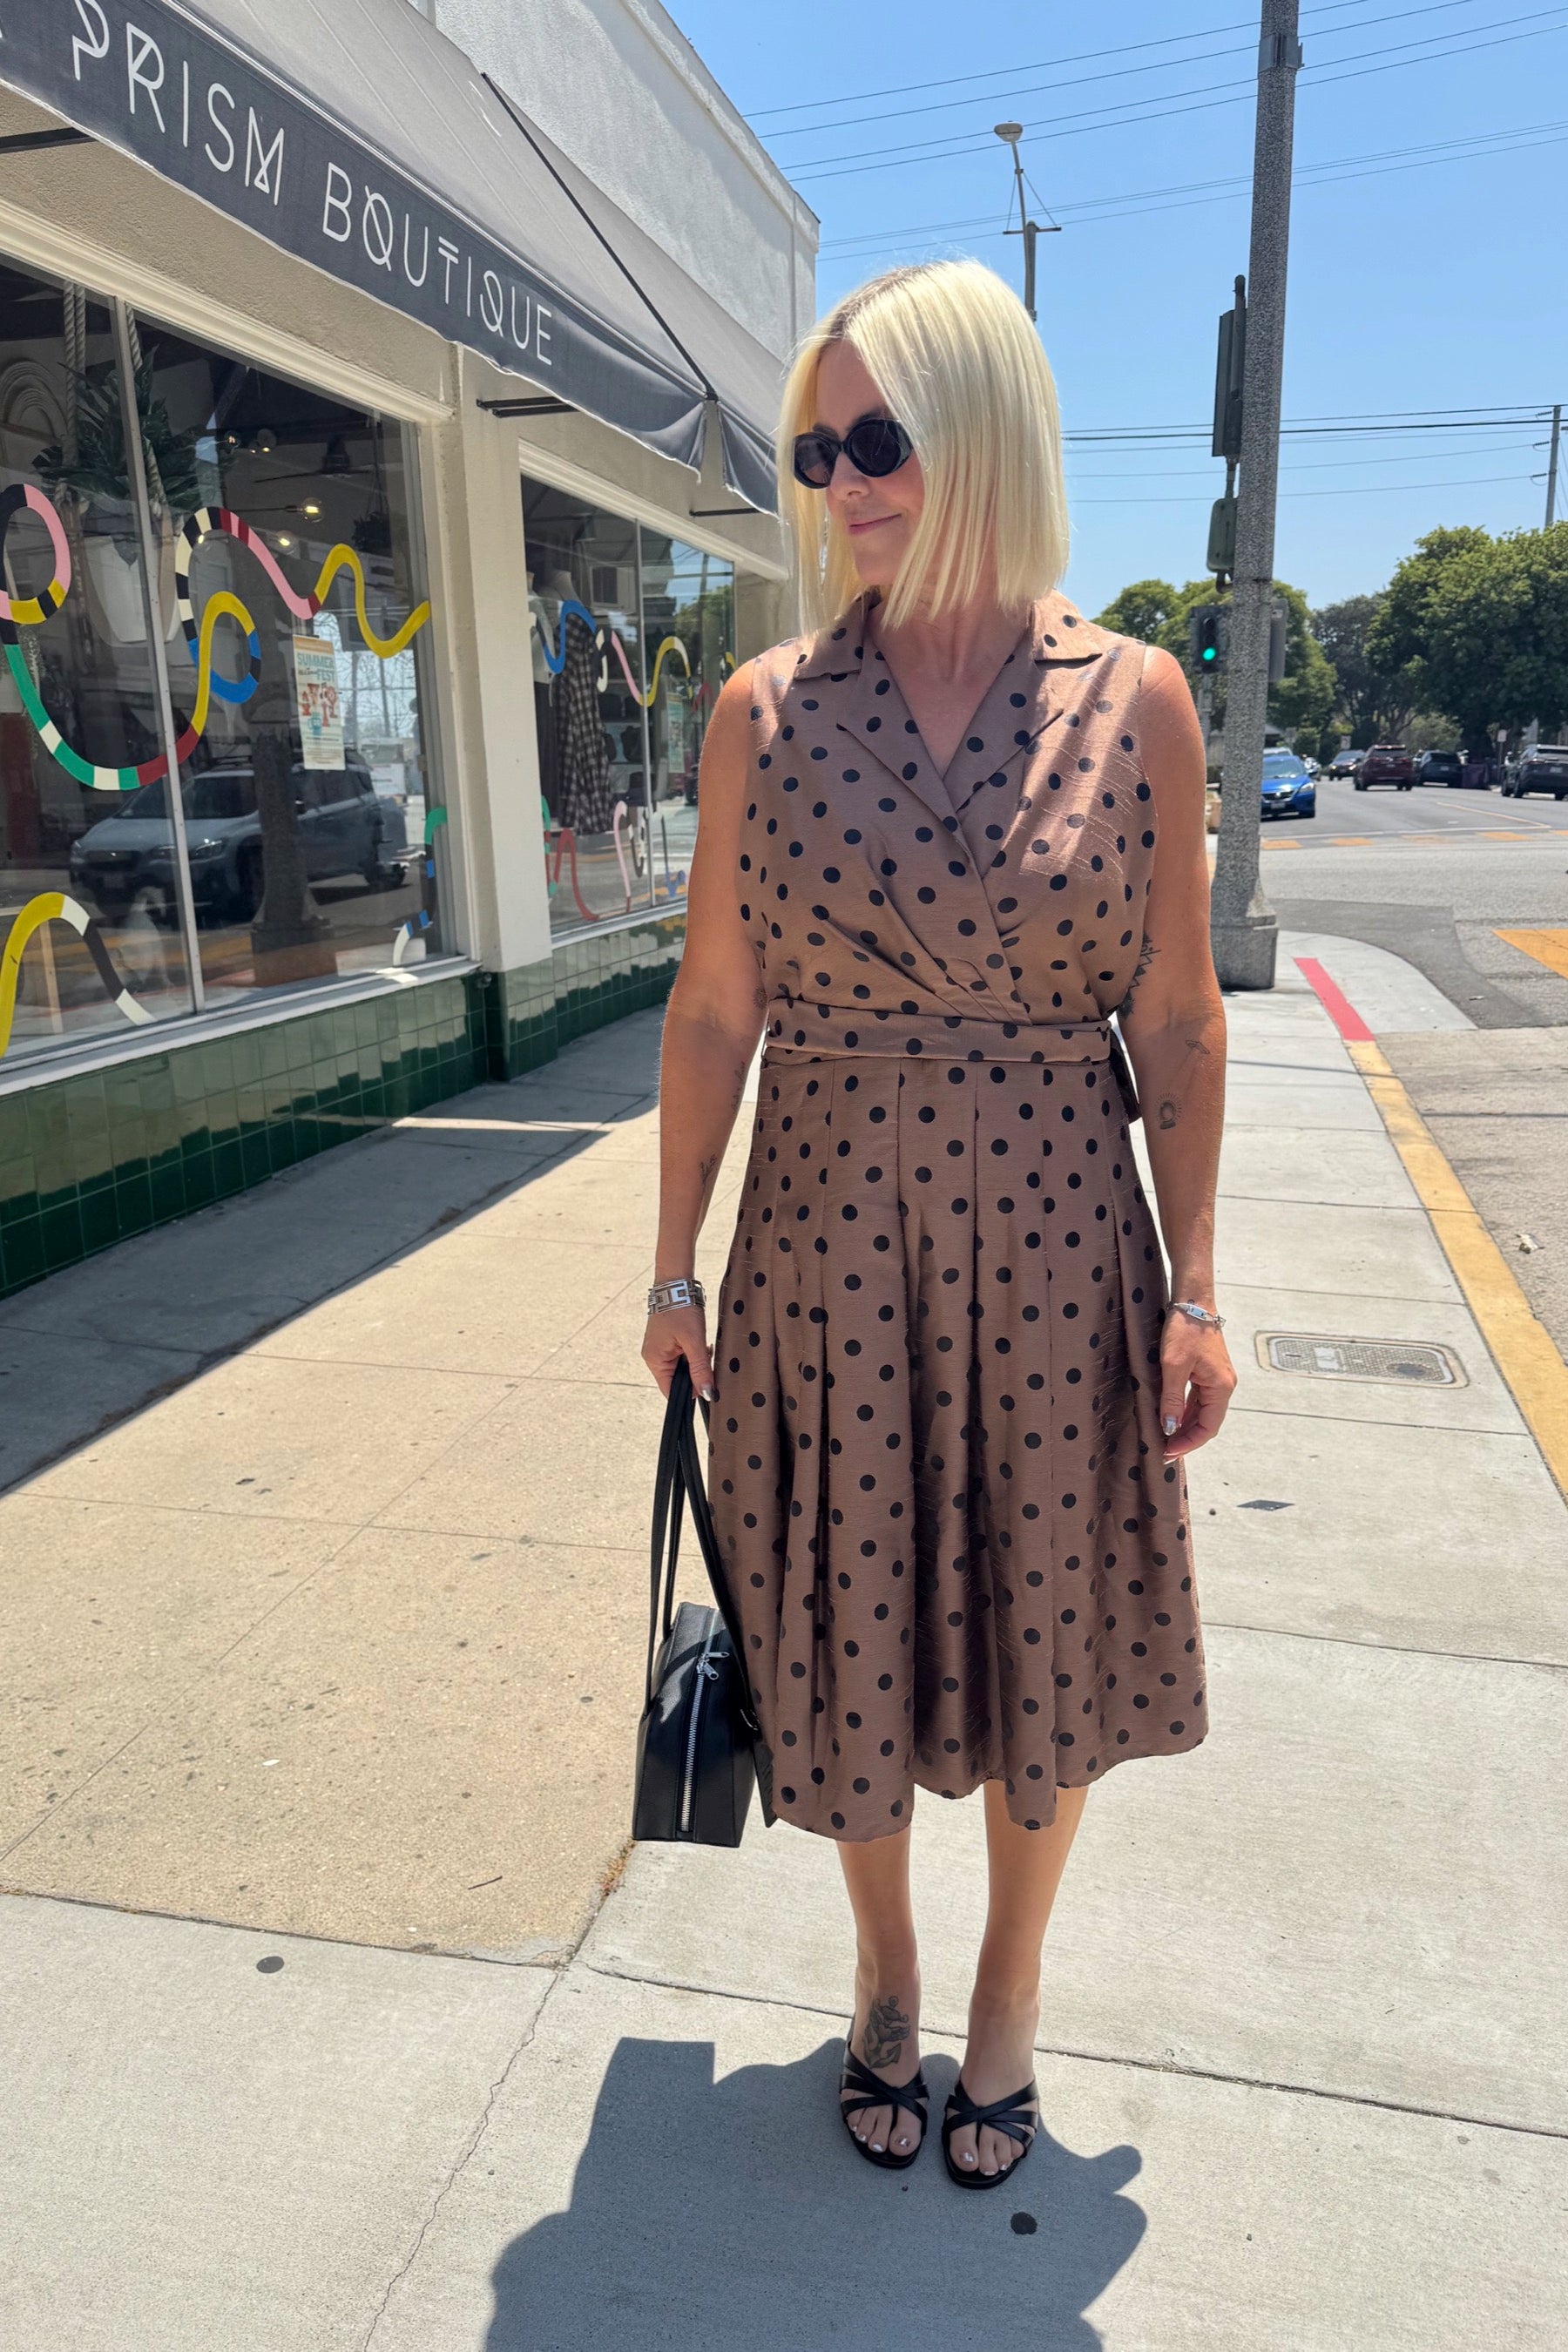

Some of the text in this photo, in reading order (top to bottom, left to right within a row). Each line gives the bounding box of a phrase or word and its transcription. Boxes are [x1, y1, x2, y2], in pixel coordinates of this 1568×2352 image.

[72, 0, 552, 366] PRISM BOUTIQUE
[297, 652, 335, 669] SUMMER
[316, 669, 335, 682] FEST
